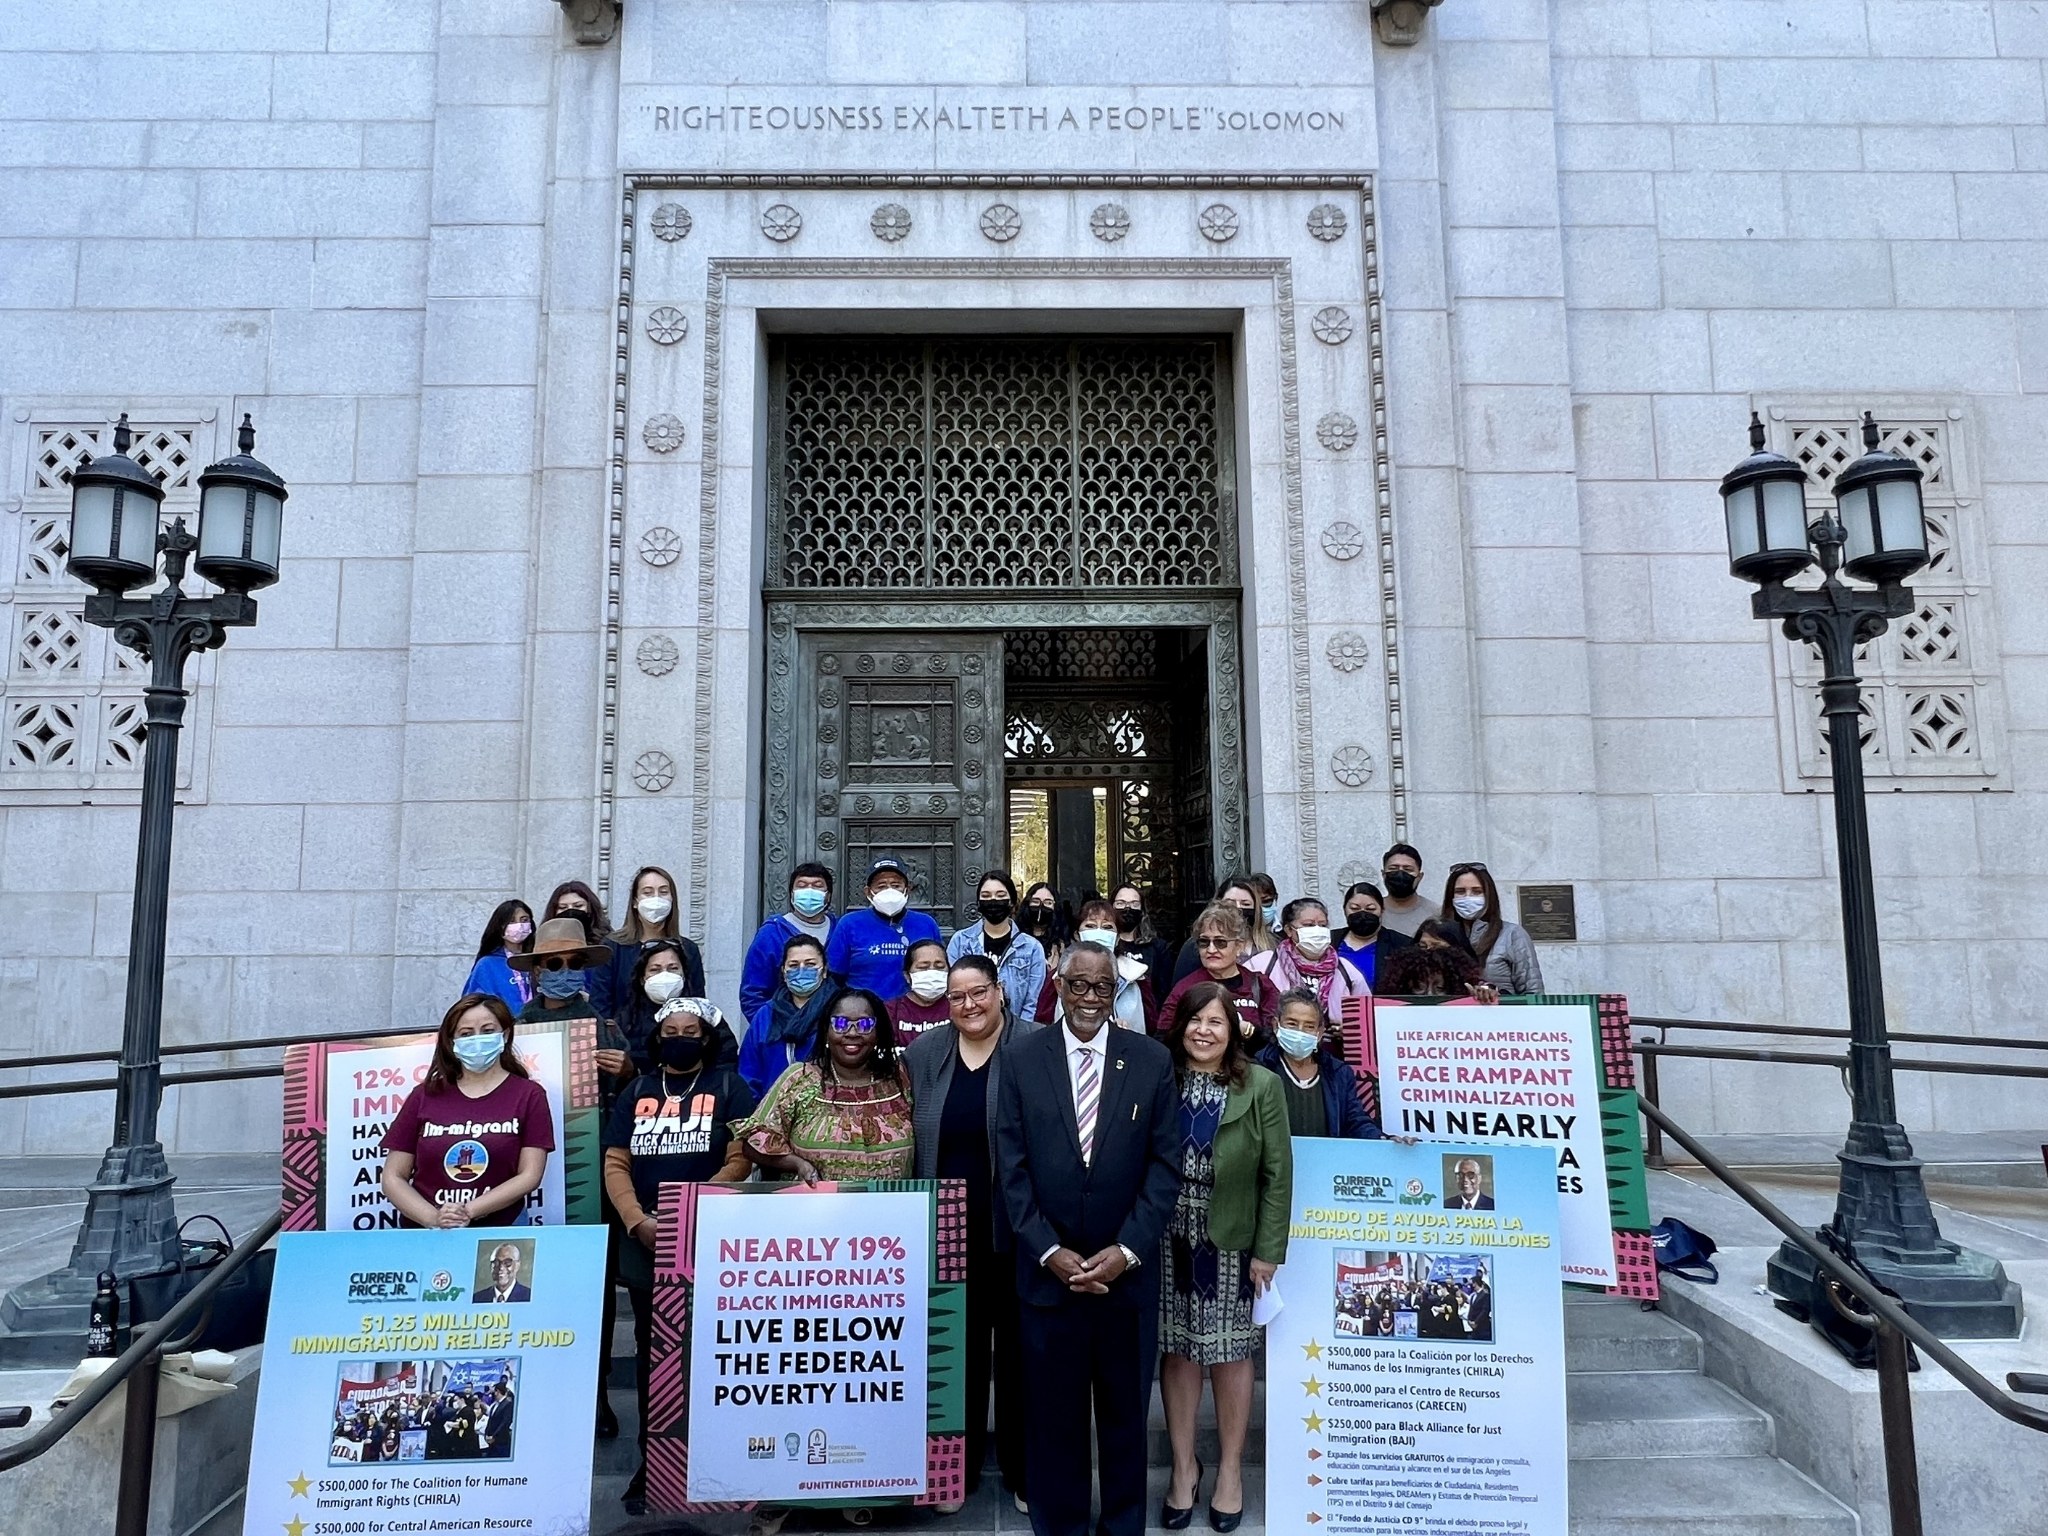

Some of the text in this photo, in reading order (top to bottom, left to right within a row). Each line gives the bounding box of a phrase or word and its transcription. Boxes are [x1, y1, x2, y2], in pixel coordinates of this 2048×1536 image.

[894, 105, 1048, 131] EXALTETH
[1058, 106, 1079, 131] A
[1217, 111, 1346, 131] SOLOMON
[1396, 1031, 1573, 1044] LIKE AFRICAN AMERICANS,
[1396, 1047, 1571, 1062] BLACK IMMIGRANTS
[353, 1068, 406, 1091] 12%
[1398, 1066, 1573, 1086] FACE RAMPANT
[1400, 1088, 1576, 1107] CRIMINALIZATION
[633, 1093, 716, 1135] BAJI
[1402, 1109, 1577, 1140] IN NEARLY
[661, 1131, 711, 1146] ALLIANCE
[658, 1142, 710, 1155] IMMIGRATION
[1333, 1174, 1394, 1188] CURREN D.
[1333, 1186, 1386, 1199] PRICE, JR.
[1303, 1208, 1523, 1231] FONDO DE AYUDA PARA LA
[1395, 1230, 1416, 1244] DE
[1470, 1233, 1551, 1249] MILLONES
[719, 1236, 906, 1263] NEARLY 19%
[350, 1271, 418, 1285] CURREN D.
[719, 1267, 906, 1288] OF CALIFORNIA'S
[348, 1284, 408, 1299] PRICE, JR.
[717, 1293, 906, 1311] BLACK IMMIGRANTS
[361, 1312, 510, 1334] $1.25 MILLION
[716, 1316, 905, 1344] LIVE BELOW
[290, 1329, 576, 1354] IMMIGRATION RELIEF FUND
[714, 1350, 904, 1376] THE FEDERAL
[1327, 1346, 1534, 1364] $500,000 para la Coalición por los Derechos
[1327, 1361, 1505, 1379] Humanos de los Inmigrantes (CHIRLA)
[714, 1381, 904, 1407] POVERTY LINE
[1327, 1382, 1501, 1399] $500,000 para el Centro de Recursos
[1327, 1396, 1467, 1413] Centroamericanos (CARECEN)
[1327, 1418, 1502, 1435] $250,000 para Black Alliance for Just
[748, 1437, 776, 1452] BAJI
[1327, 1433, 1416, 1447] Immigration (BAJI)
[1327, 1450, 1357, 1460] Expande
[1359, 1451, 1370, 1460] los
[1372, 1453, 1402, 1461] servicios
[1404, 1453, 1445, 1462] GRATUITOS
[1472, 1467, 1484, 1475] Los
[318, 1475, 528, 1493] $500,000 for The Coalition for Humane
[798, 1478, 919, 1491] #UNITINGTHEDIASPORA
[1327, 1477, 1348, 1485] Cubre
[1350, 1478, 1373, 1486] tarifas
[316, 1493, 461, 1511] Immigrant Rights (CHIRLA)
[314, 1517, 533, 1535] $500,000 for Central American Resource
[1402, 1516, 1413, 1524] CD
